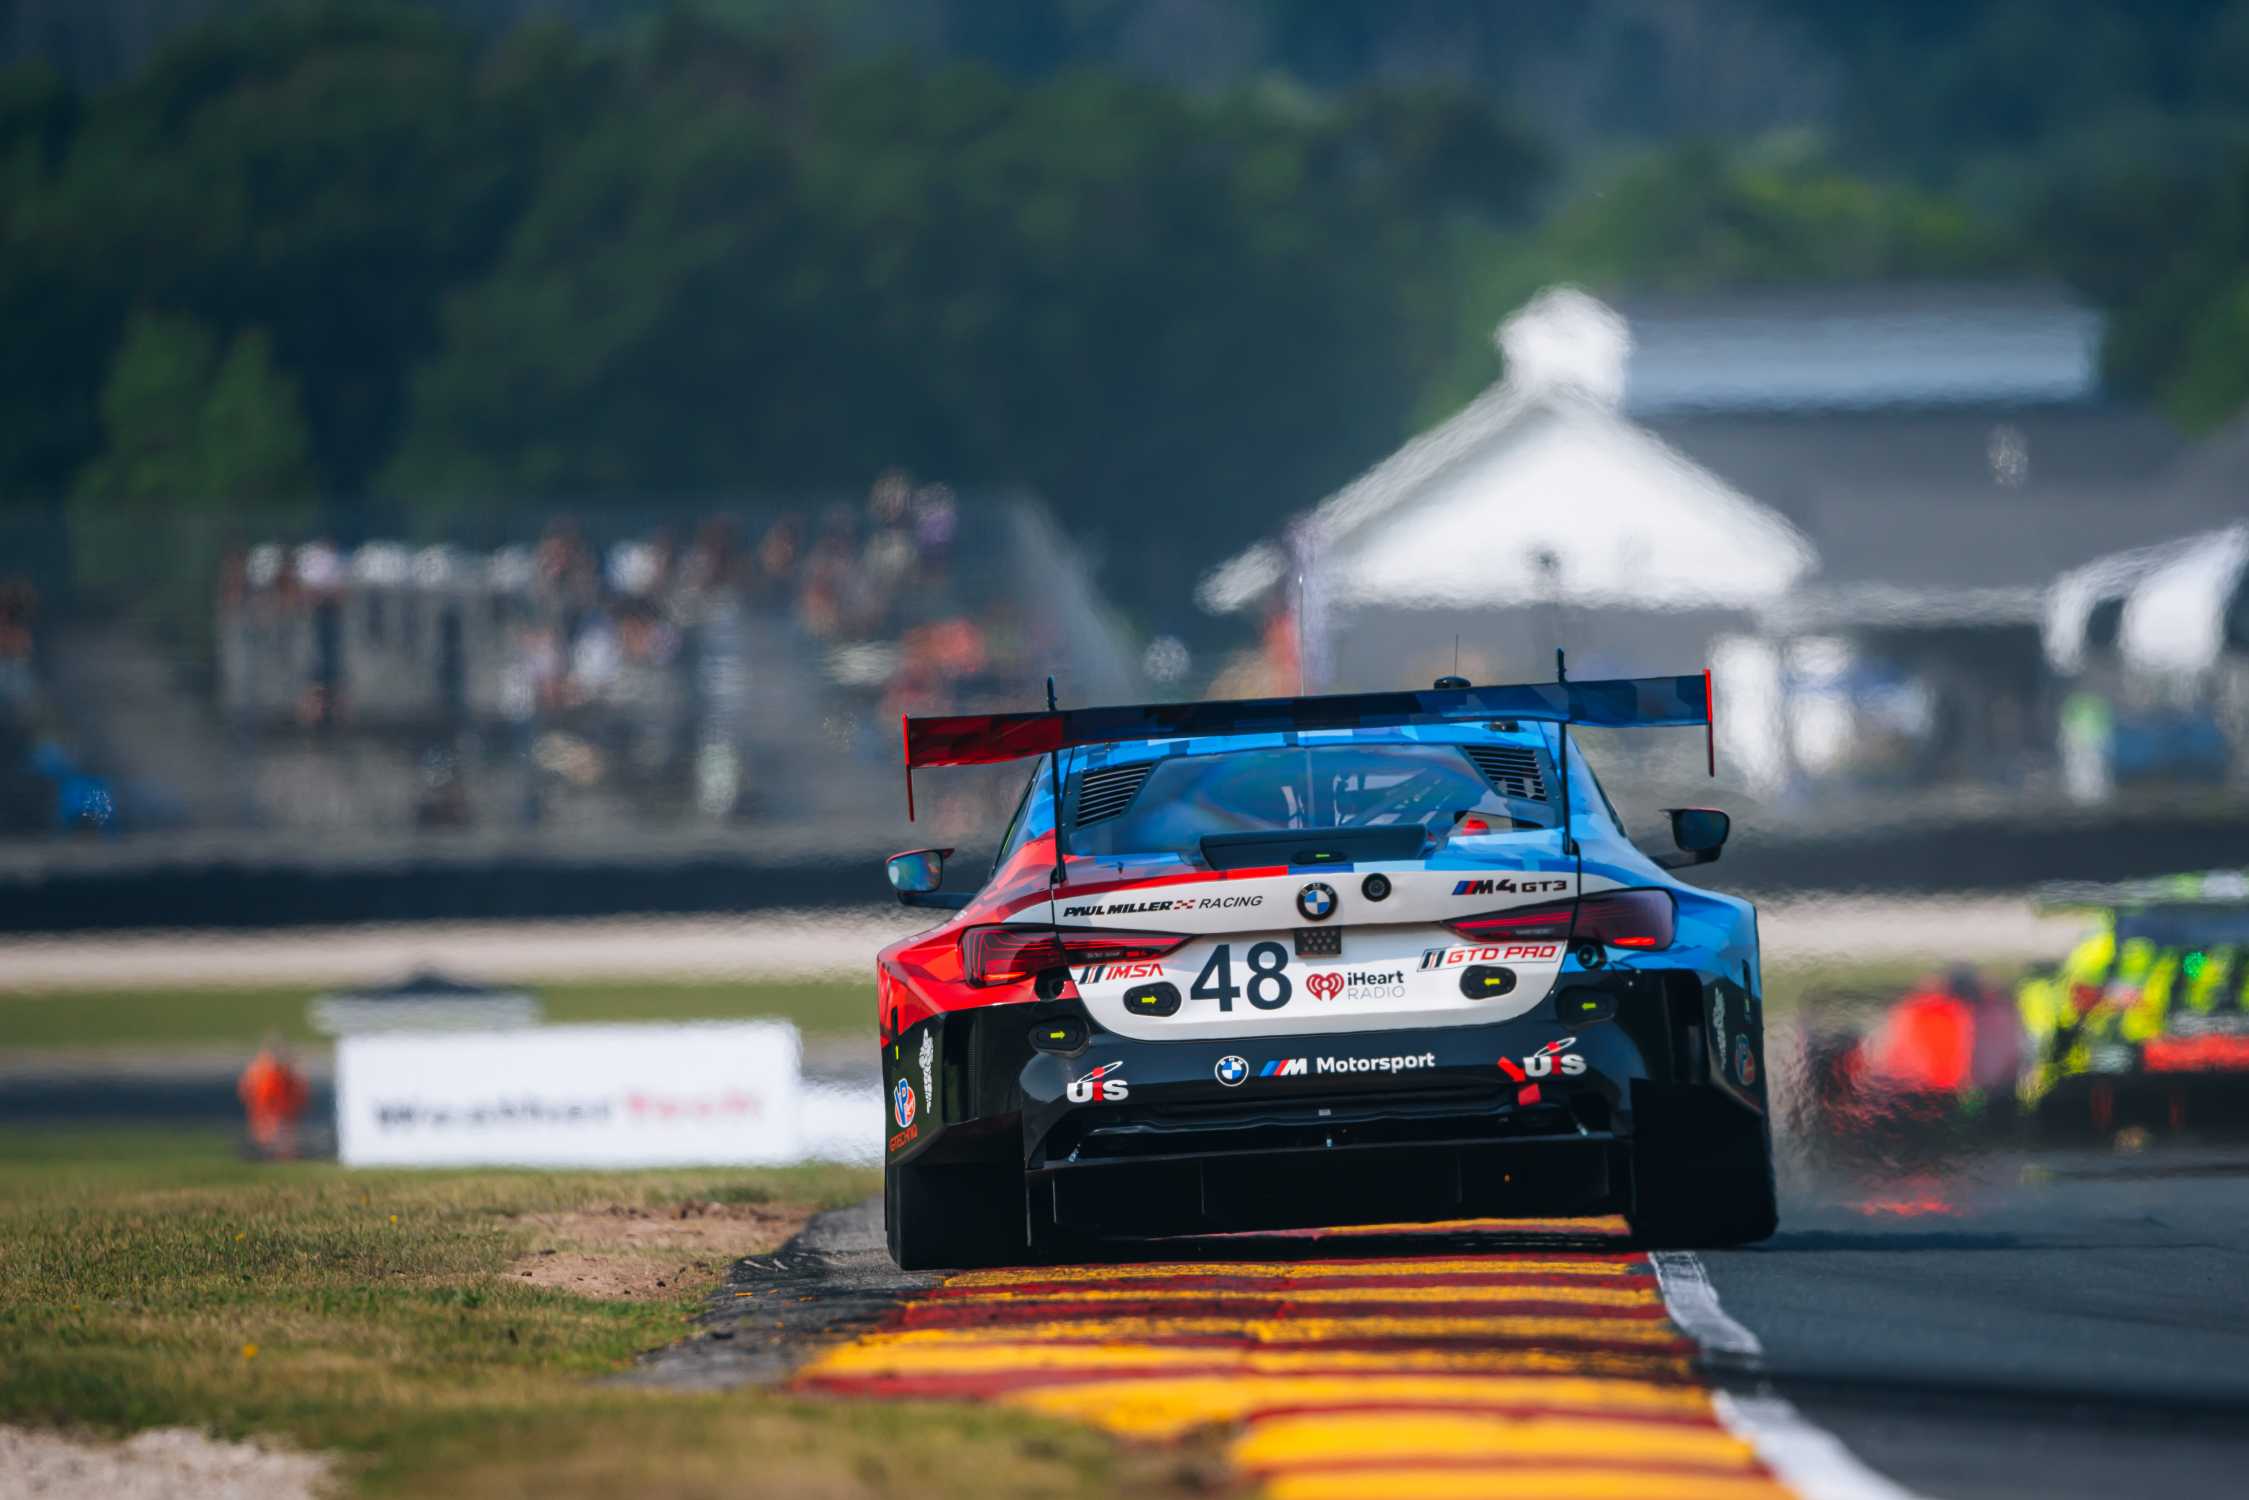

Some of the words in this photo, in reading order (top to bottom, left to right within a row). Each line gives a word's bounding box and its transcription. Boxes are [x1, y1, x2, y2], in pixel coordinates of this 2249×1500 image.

[1521, 880, 1567, 892] GT3
[1064, 905, 1105, 917] PAUL
[1106, 900, 1174, 915] MILLER
[1199, 895, 1264, 909] RACING
[1446, 947, 1500, 964] GTD
[1504, 945, 1557, 959] PRO
[1190, 941, 1293, 1012] 48
[1347, 970, 1404, 986] iHeart
[1347, 985, 1406, 1000] RADIO
[1316, 1052, 1436, 1074] Motorsport
